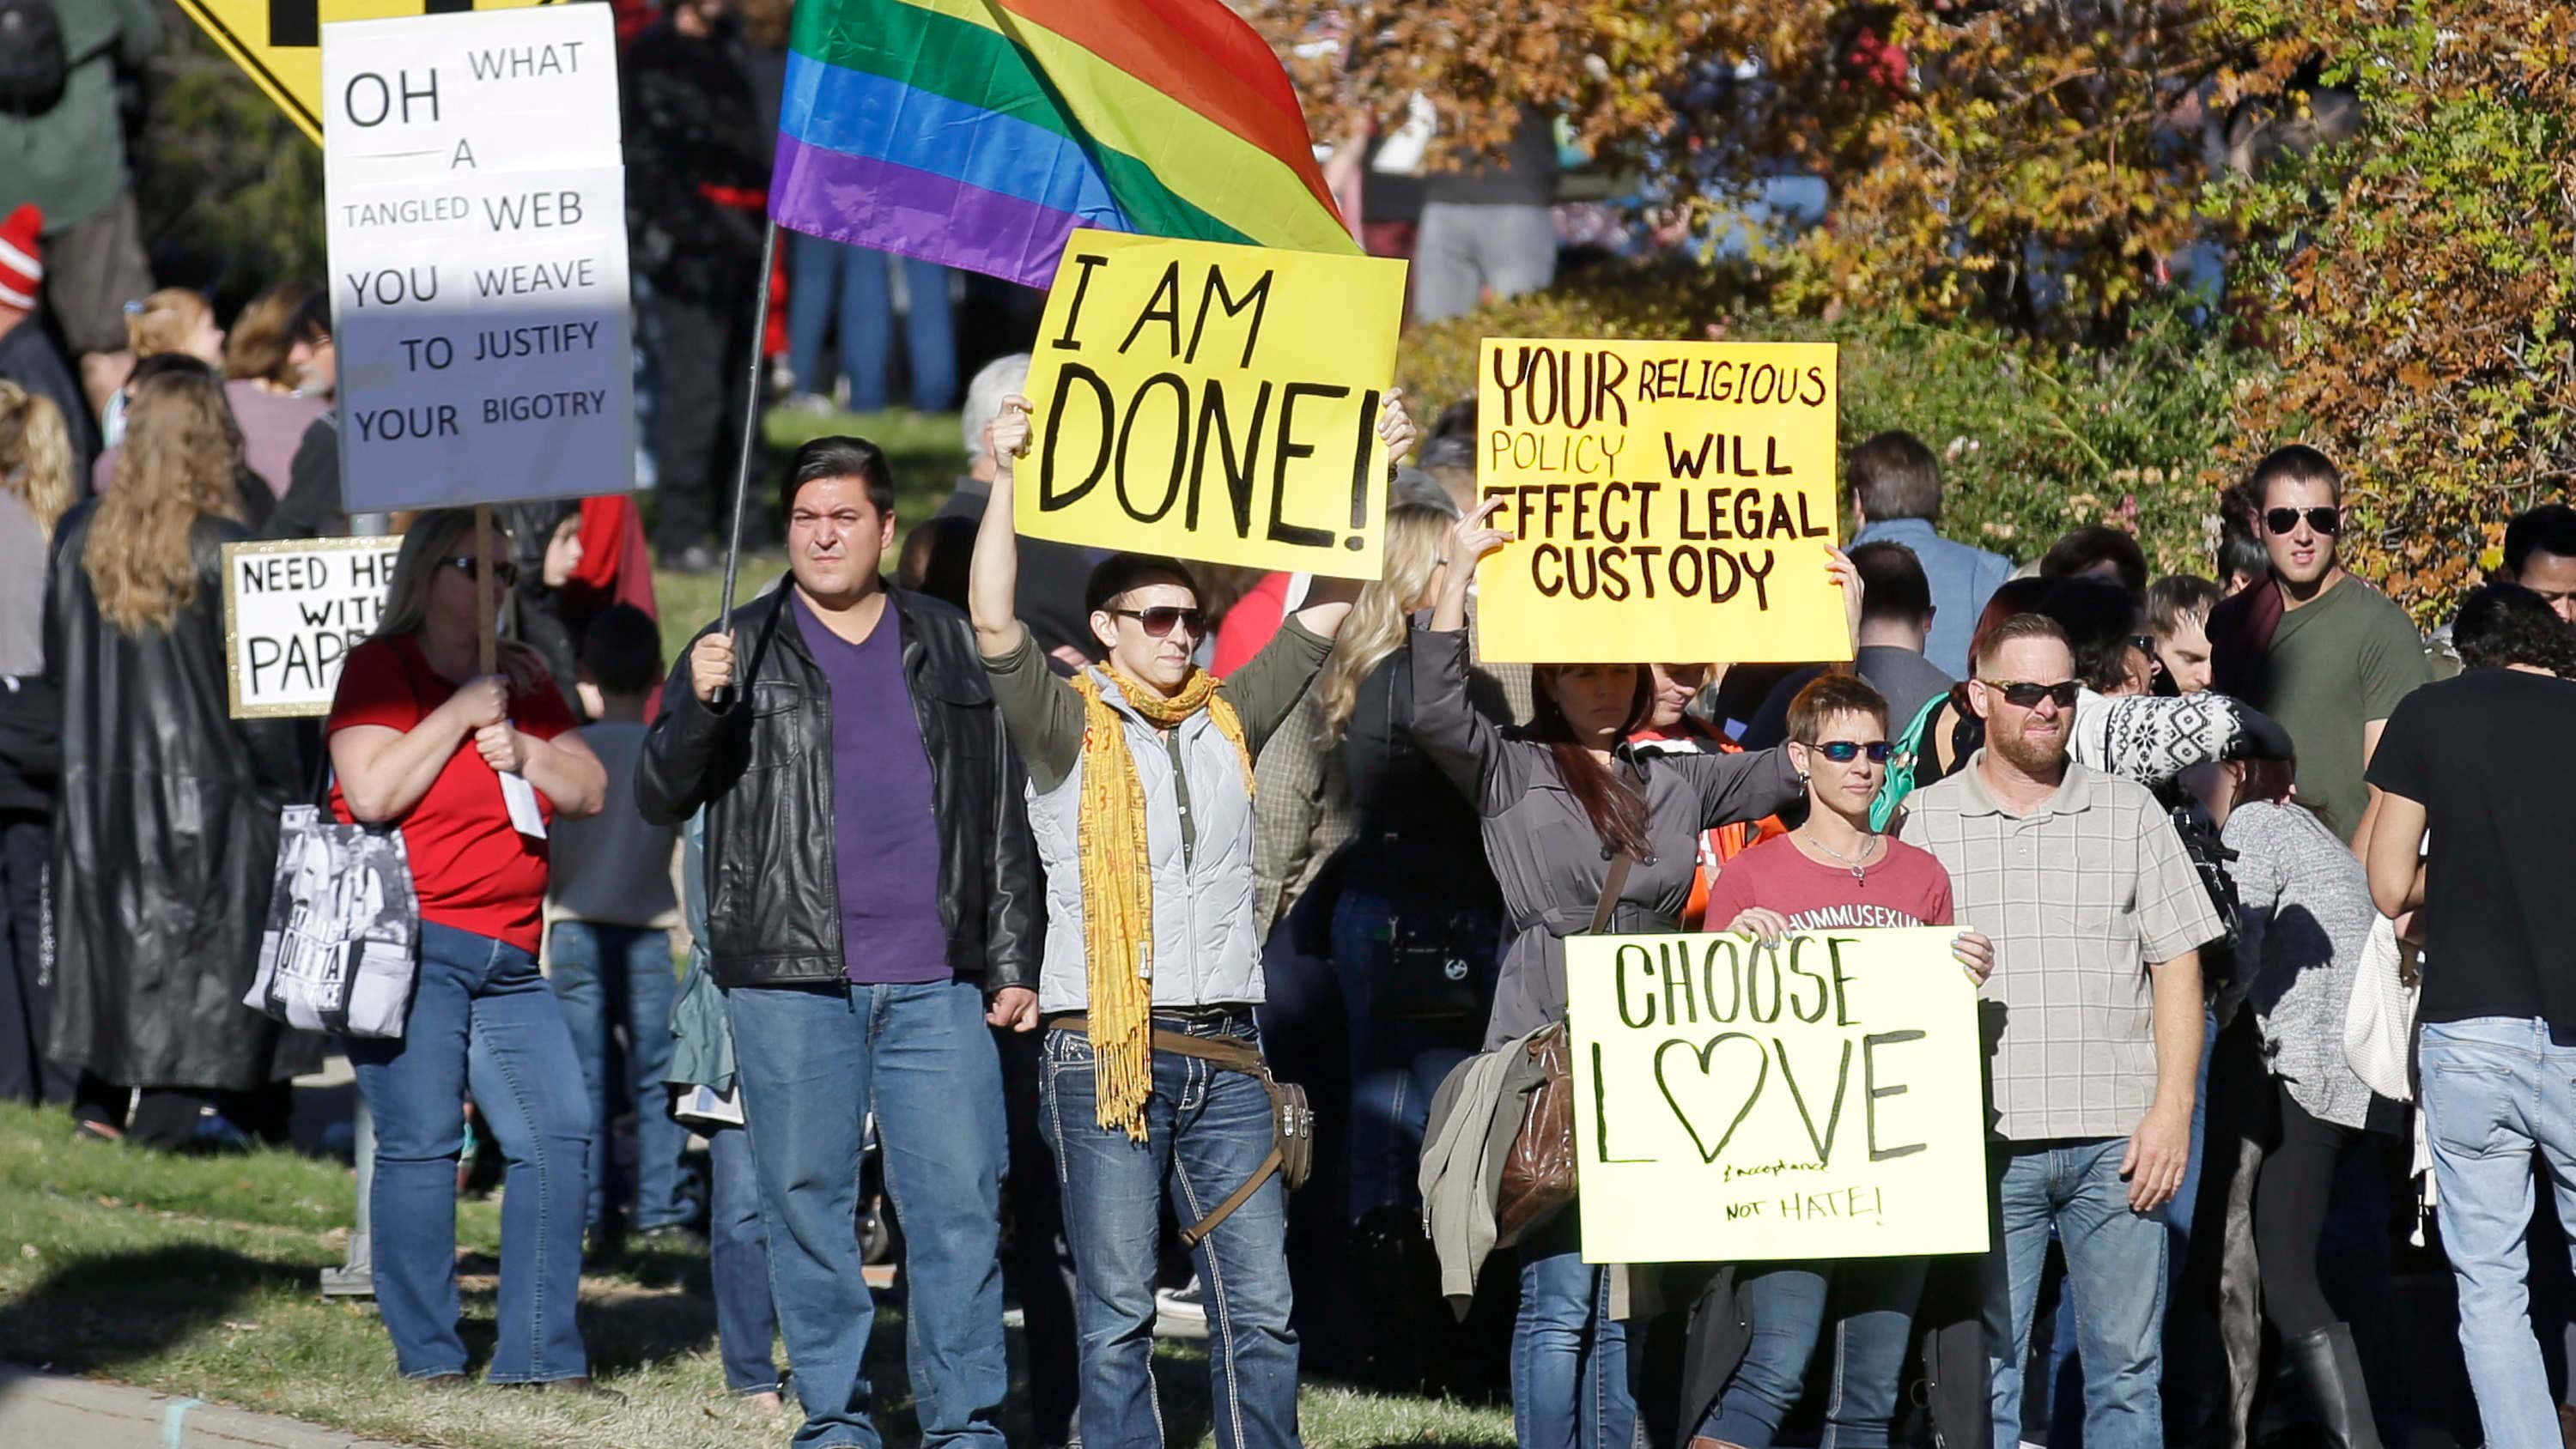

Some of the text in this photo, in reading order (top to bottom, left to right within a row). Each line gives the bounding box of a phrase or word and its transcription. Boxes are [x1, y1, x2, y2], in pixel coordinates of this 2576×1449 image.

[345, 41, 583, 127] OH WHAT
[451, 138, 477, 169] A
[343, 191, 583, 232] TANGLED WEB
[348, 258, 595, 307] YOU WEAVE
[1052, 254, 1273, 368] I AM
[400, 321, 598, 372] TO JUSTIFY
[1493, 346, 1826, 429] YOUR RELIGIOUS
[355, 389, 606, 443] YOUR BIGOTRY
[1040, 362, 1380, 552] DONE!
[1492, 430, 1793, 479] POLICY WILL
[1484, 482, 1830, 543] EFFECT LEGAL
[244, 552, 399, 594] NEED HE
[1532, 543, 1775, 611] CUSTODY
[1789, 904, 1925, 931] HUMMUSEXUA
[1616, 936, 1862, 1028] CHOOSE
[1726, 1185, 1883, 1226] NOT HATE!
